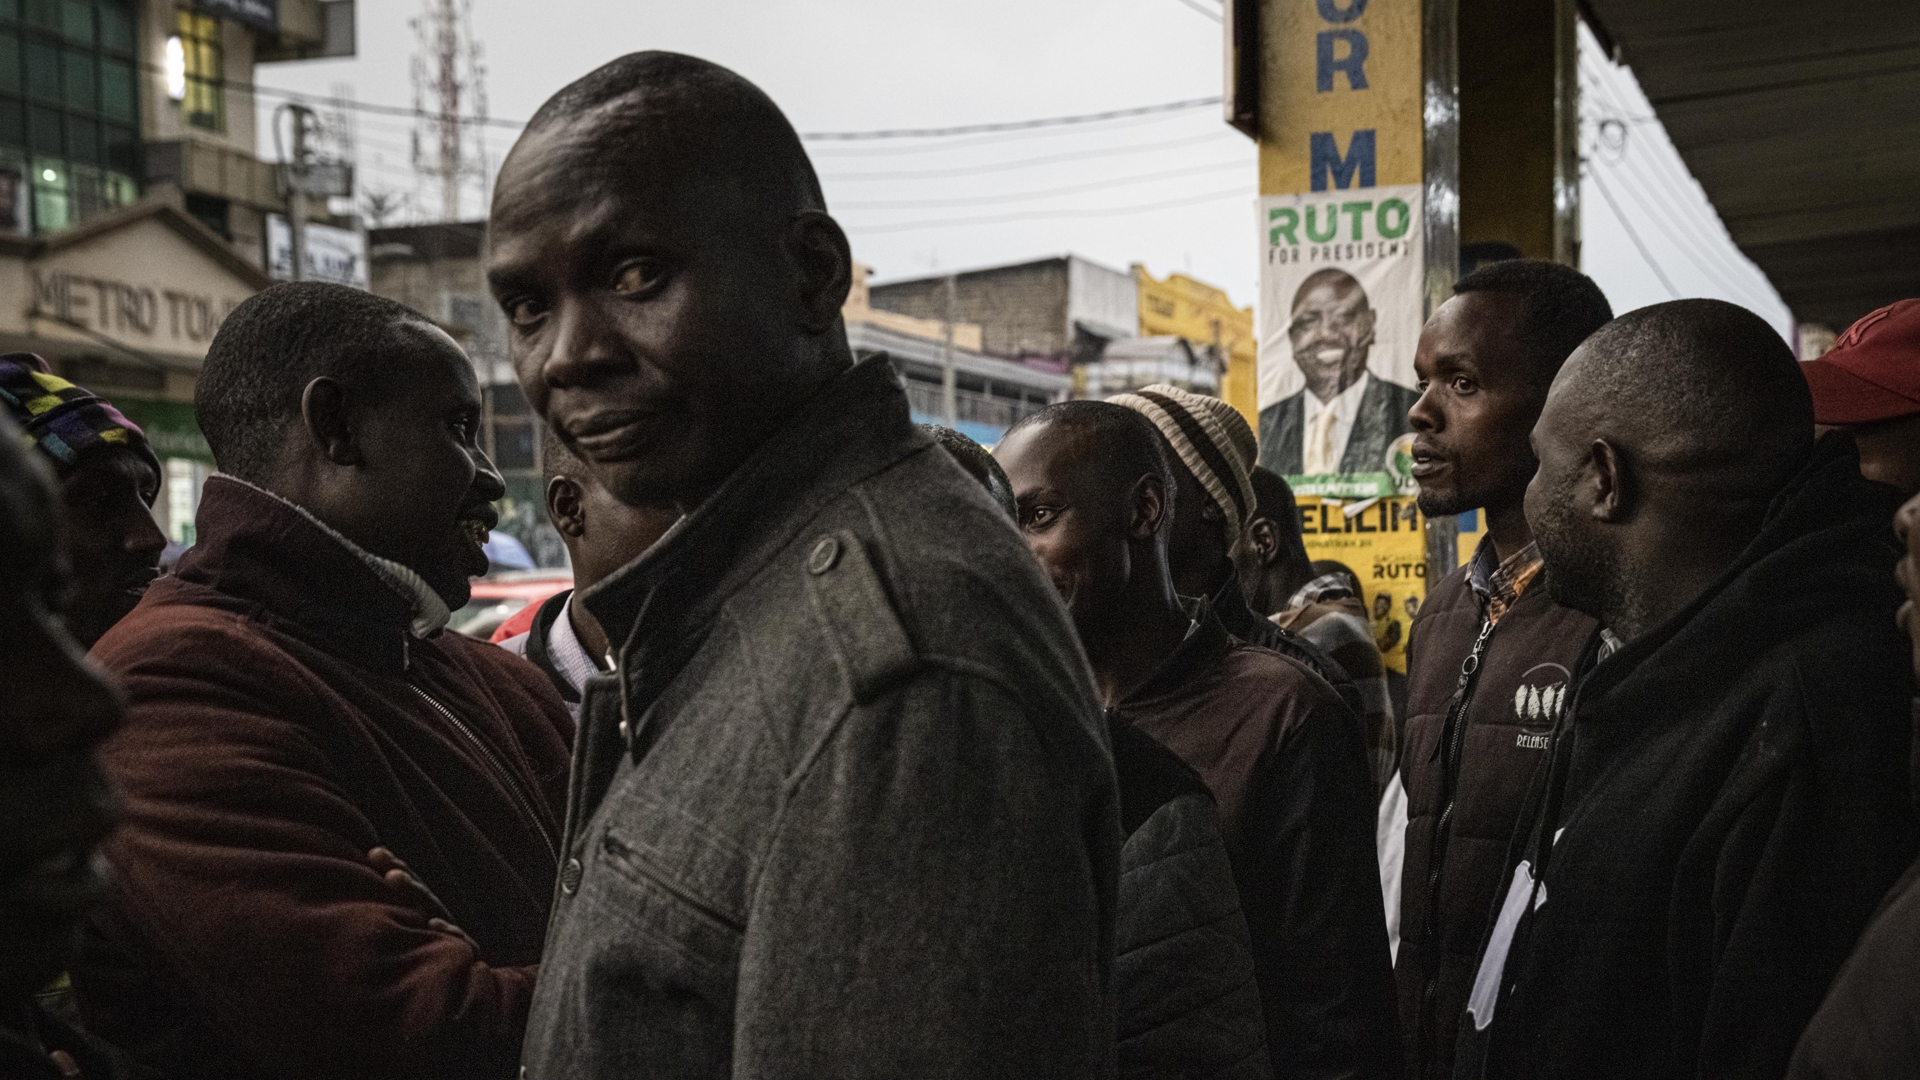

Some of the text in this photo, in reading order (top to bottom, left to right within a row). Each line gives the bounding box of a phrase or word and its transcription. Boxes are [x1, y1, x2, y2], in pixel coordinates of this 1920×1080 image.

[1310, 129, 1376, 192] M
[1269, 197, 1410, 247] RUTO
[1268, 247, 1300, 265] FOR
[30, 267, 158, 336] METRO
[1372, 563, 1427, 579] RUTO
